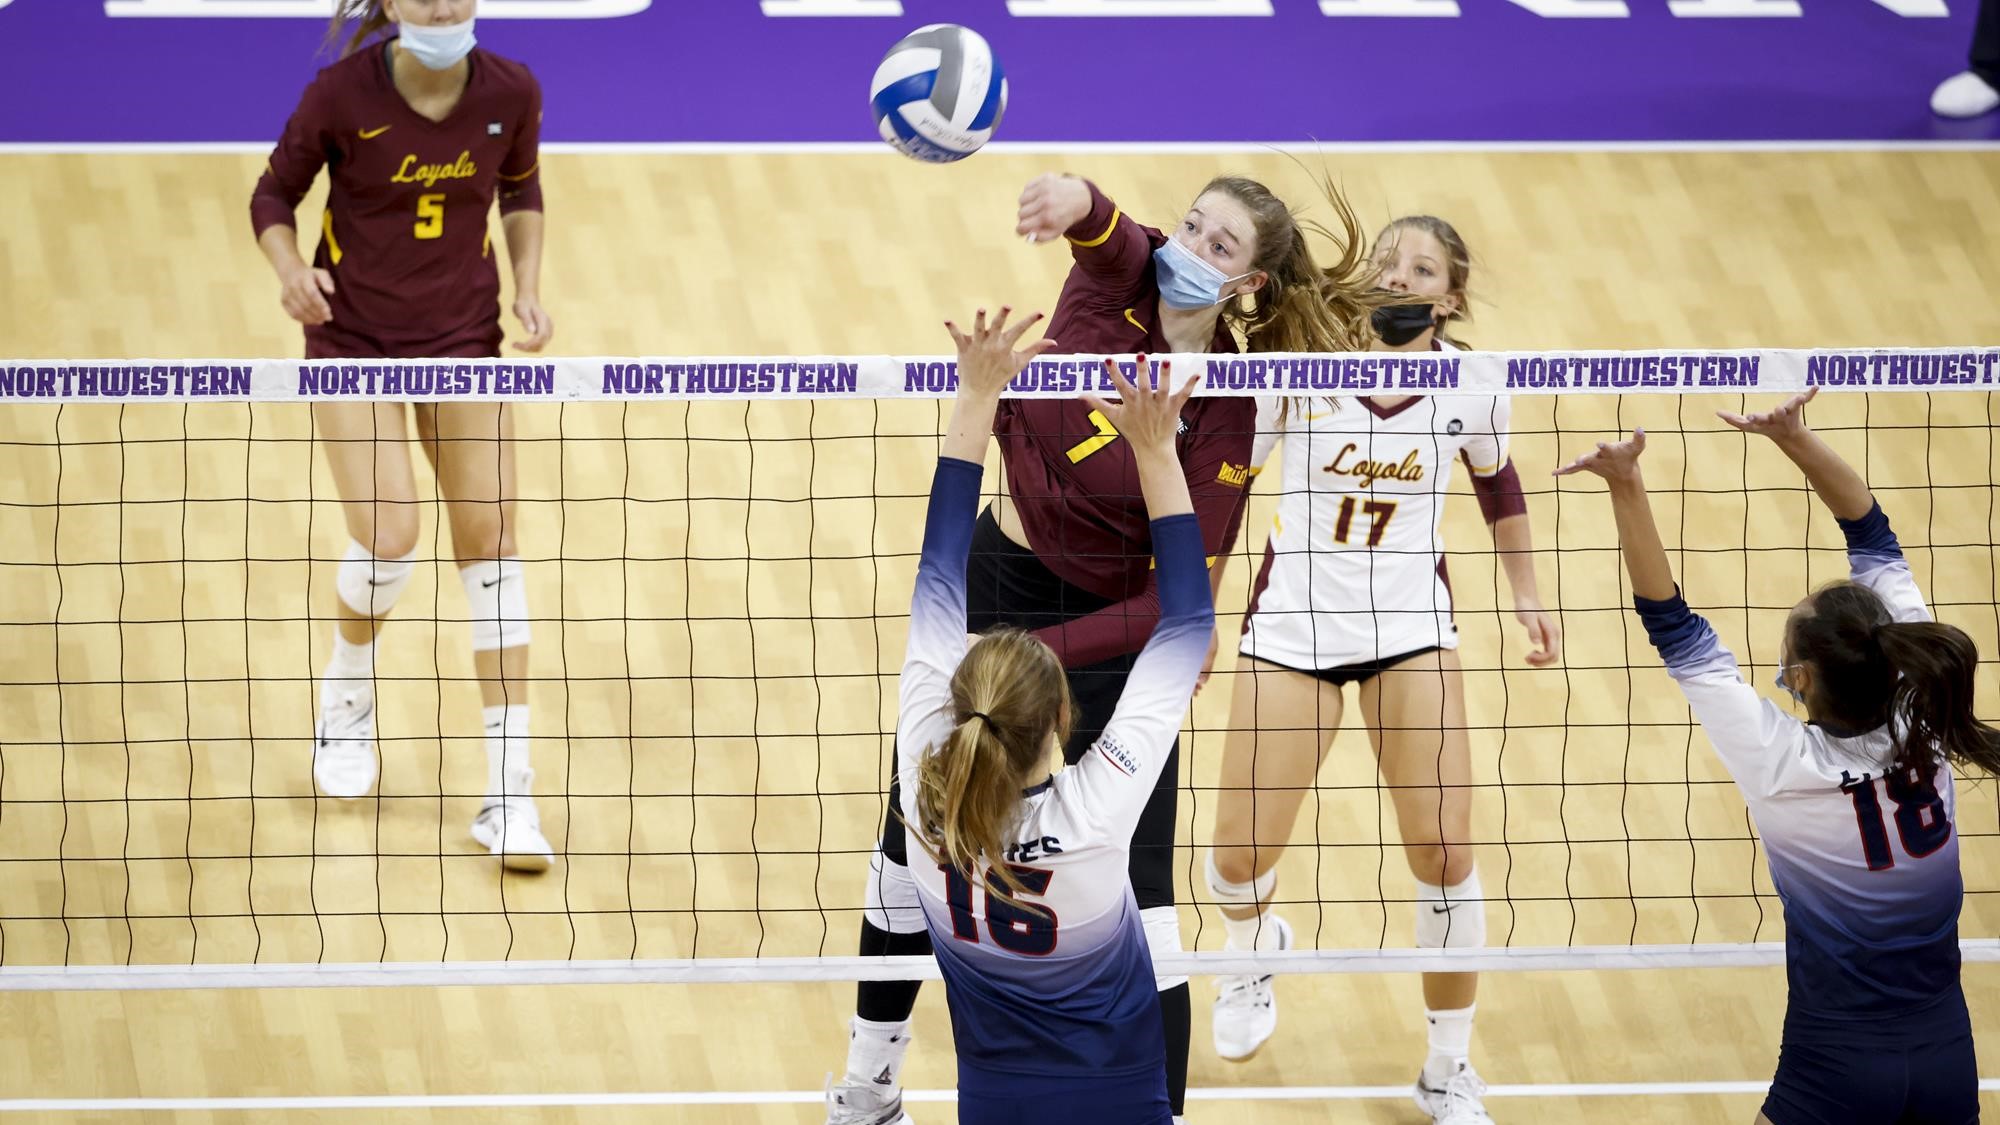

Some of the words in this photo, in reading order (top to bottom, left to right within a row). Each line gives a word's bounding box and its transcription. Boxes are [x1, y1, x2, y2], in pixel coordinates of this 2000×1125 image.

[391, 150, 477, 187] Loyola
[414, 193, 446, 239] 5
[0, 366, 252, 397] NORTHWESTERN
[298, 365, 555, 395] NORTHWESTERN
[602, 363, 858, 394] NORTHWESTERN
[904, 361, 1160, 392] NORWESTER
[1206, 358, 1460, 389] NORTHWESTERN
[1506, 356, 1760, 388] NORTHWESTERN
[1806, 353, 2000, 386] NORTHWEST
[1322, 443, 1424, 488] Loyola
[1333, 495, 1397, 546] 17
[1839, 757, 1951, 871] 18
[938, 846, 1058, 956] 16
